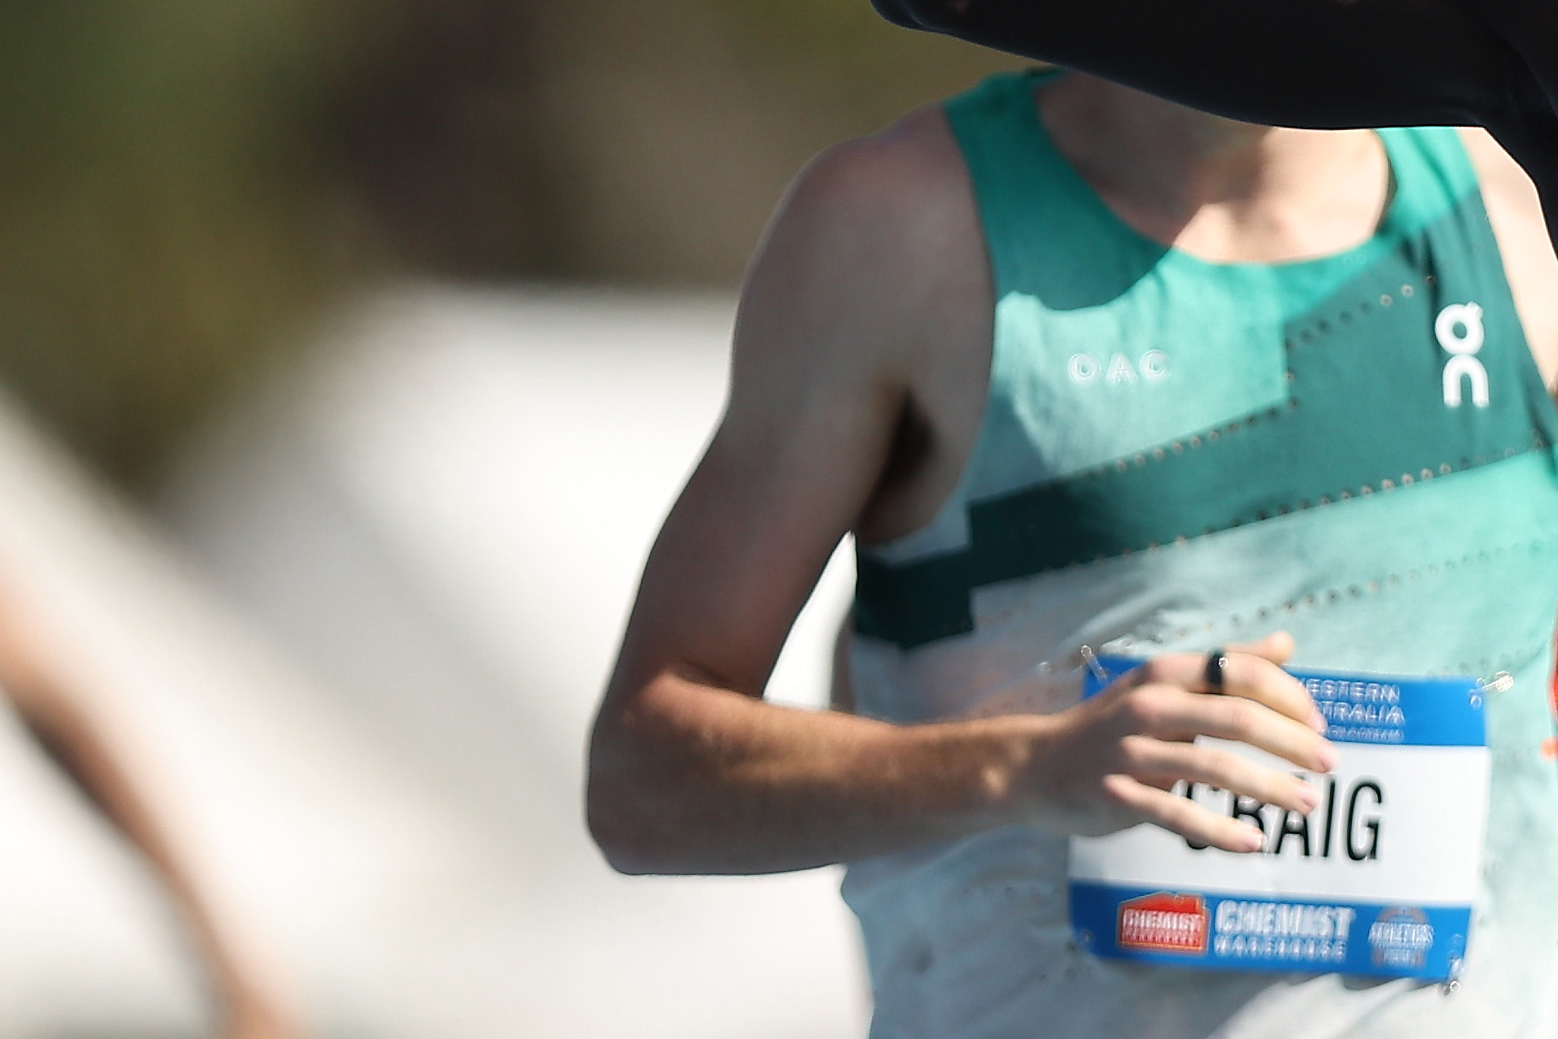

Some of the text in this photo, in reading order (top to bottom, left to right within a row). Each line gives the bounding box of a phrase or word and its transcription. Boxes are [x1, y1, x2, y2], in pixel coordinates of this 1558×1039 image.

[1068, 349, 1171, 385] OAC
[1300, 678, 1400, 703] ESTERN
[1215, 899, 1356, 939] CHEMIST
